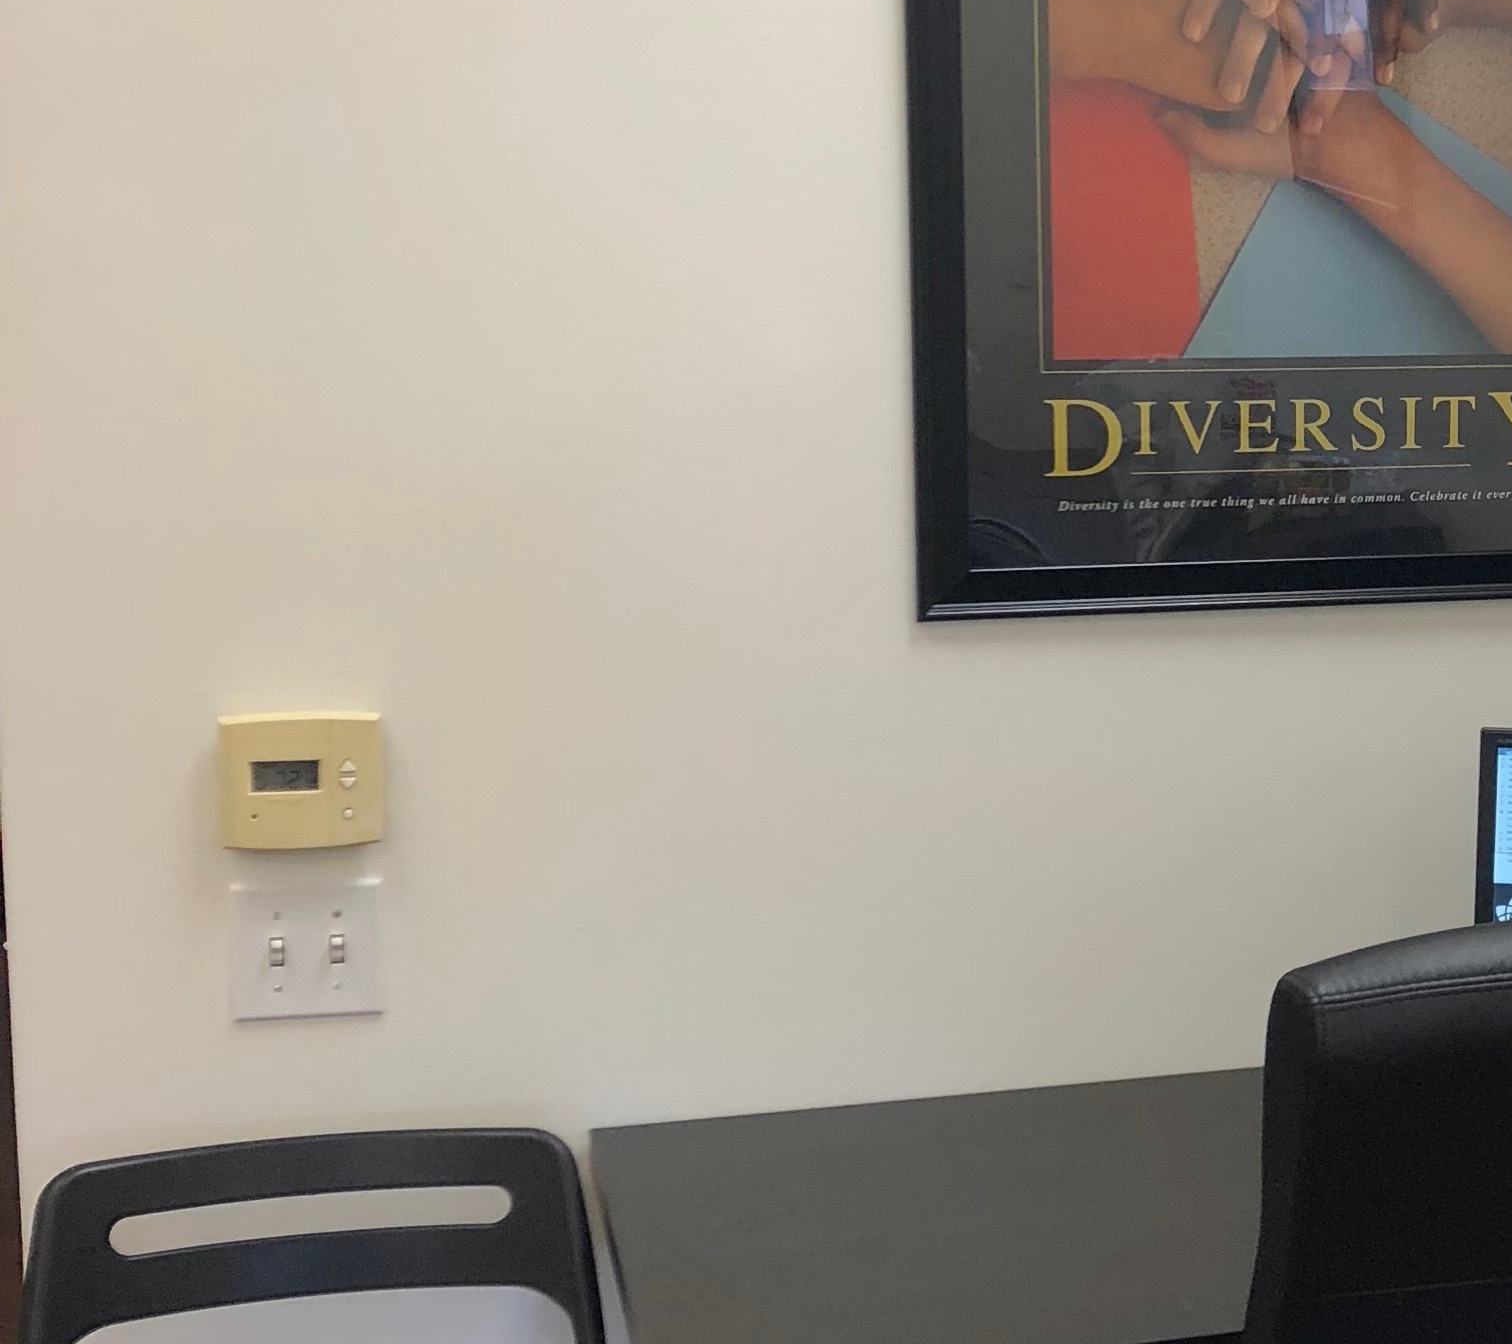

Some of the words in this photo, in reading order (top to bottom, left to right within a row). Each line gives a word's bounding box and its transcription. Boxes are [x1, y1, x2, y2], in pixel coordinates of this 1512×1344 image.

[1057, 500, 1119, 513] Diversity
[1123, 499, 1135, 510] is
[1139, 497, 1160, 510] the
[1163, 499, 1186, 509] one
[1190, 497, 1217, 508] true
[1221, 495, 1255, 509] thing
[1259, 497, 1275, 506] we
[1278, 494, 1297, 506] all
[1300, 493, 1330, 505] have
[1333, 493, 1347, 504] in
[1350, 493, 1405, 503] common.
[1409, 490, 1469, 502] Celebrate
[1472, 490, 1483, 500] it
